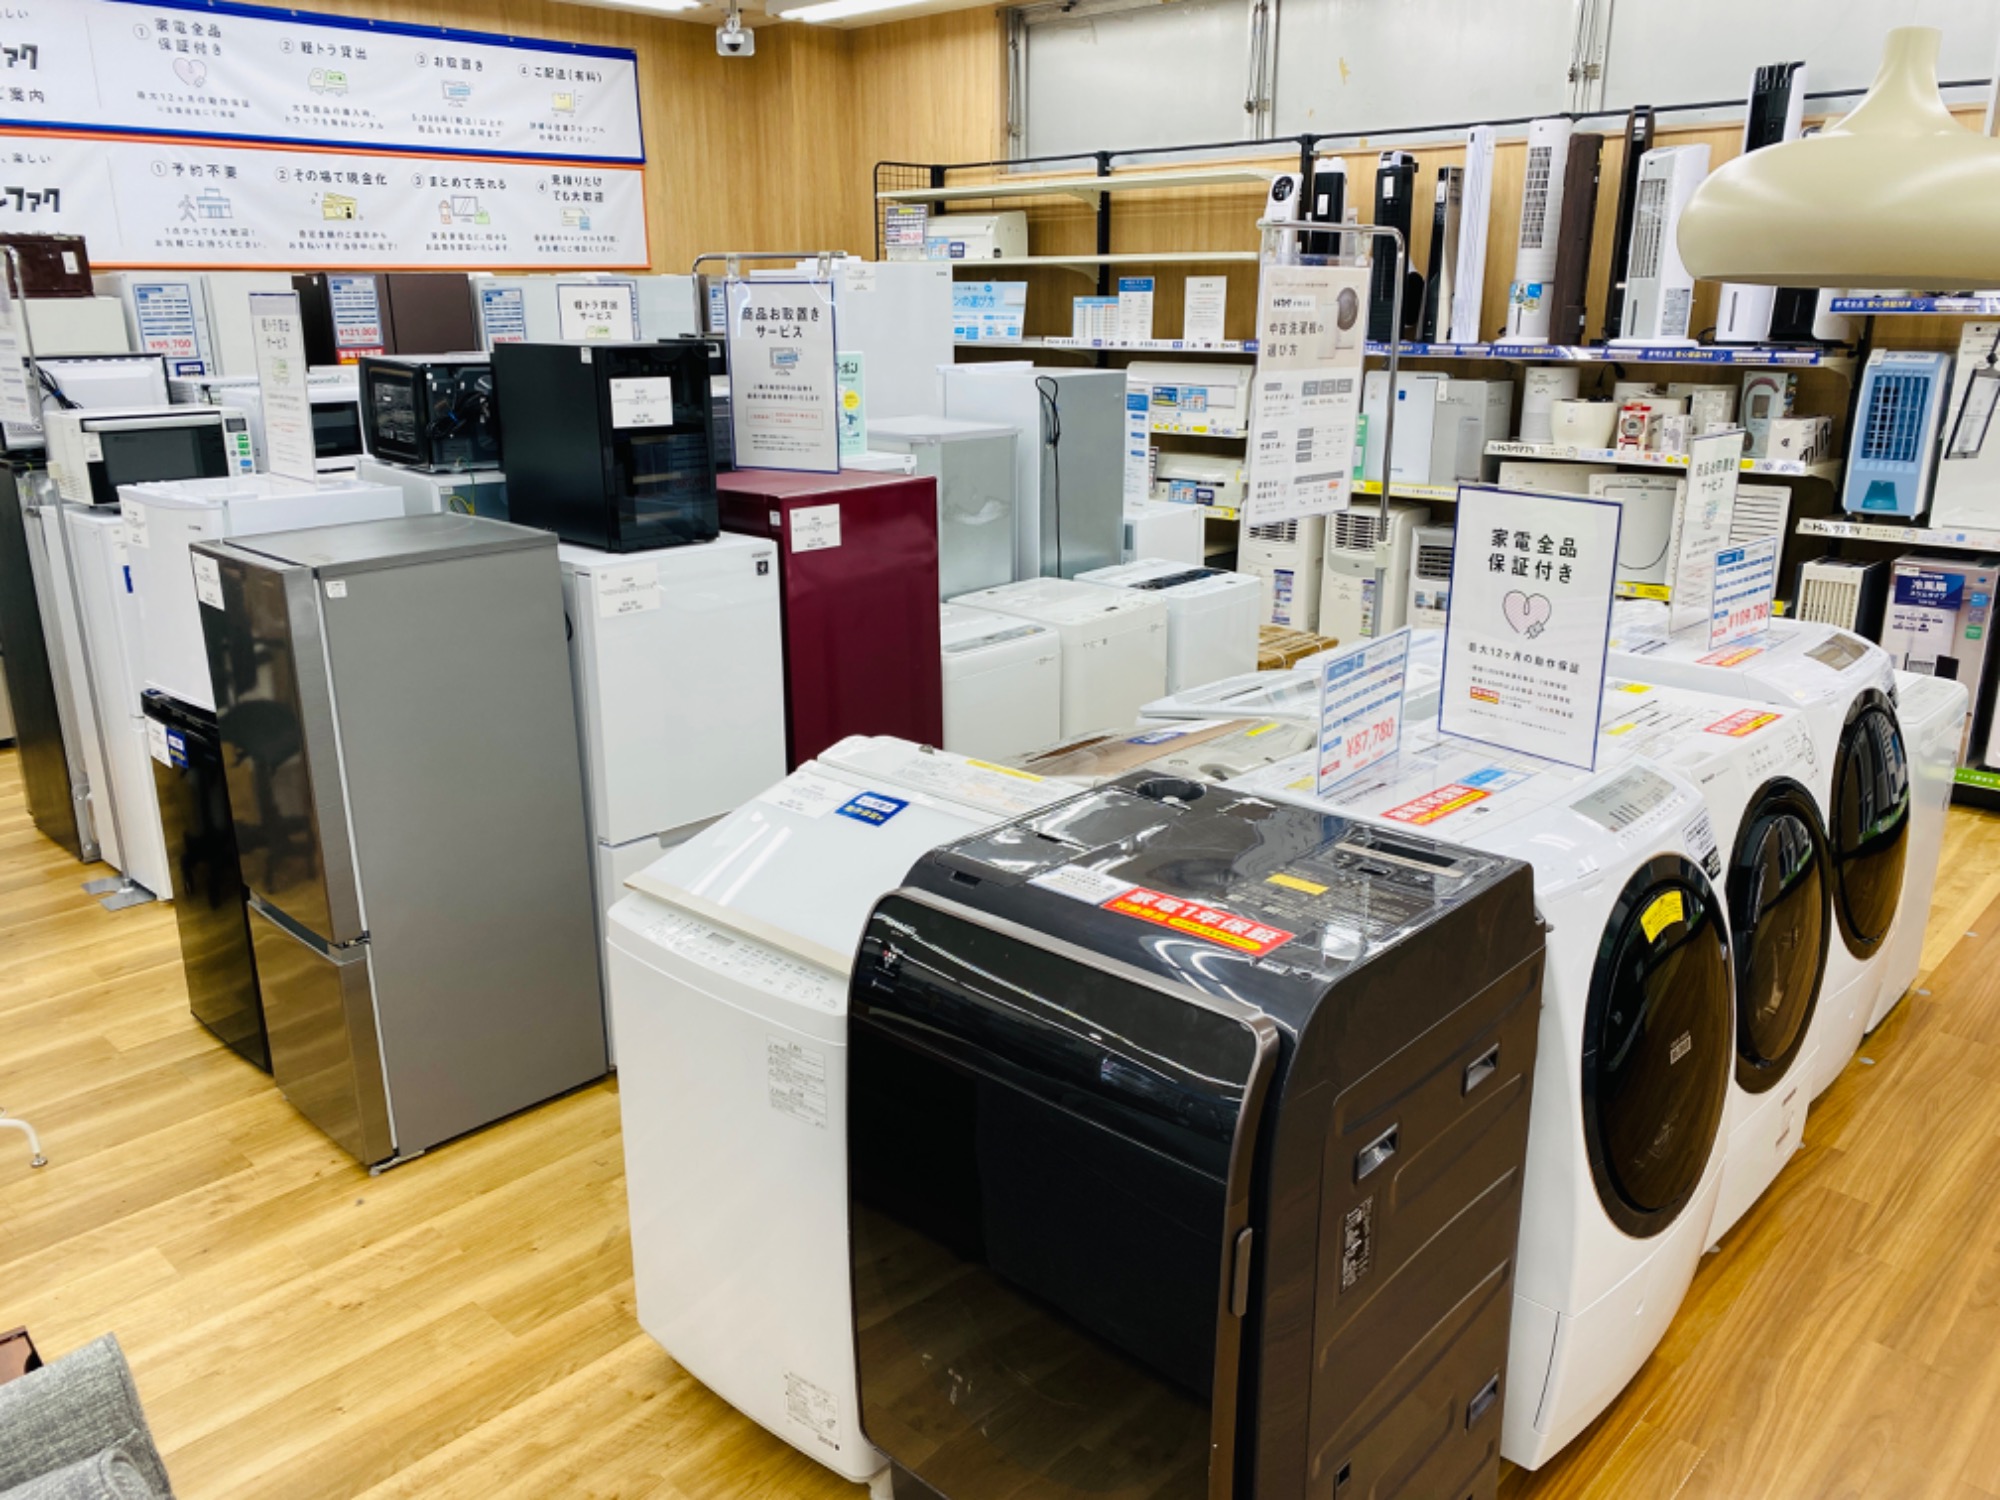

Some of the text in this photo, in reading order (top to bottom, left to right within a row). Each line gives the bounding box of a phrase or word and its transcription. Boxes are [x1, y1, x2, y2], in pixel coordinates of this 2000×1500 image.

[0, 8, 29, 19] しい
[155, 17, 222, 39] 家電全品
[158, 37, 222, 56] 保証付き
[300, 41, 368, 60] 軽トラ貸出
[0, 43, 39, 70] ァク
[433, 56, 484, 72] お取置き
[171, 162, 238, 179] 予約不要
[293, 170, 388, 187] その場で現金化
[429, 177, 506, 190] まとめて売れる
[551, 174, 602, 187] 見積りだけ
[573, 301, 618, 311] 軽トラ貸出
[741, 306, 821, 323] 商品お取置き
[580, 312, 613, 321] サービス
[755, 325, 804, 339] サービス
[1267, 343, 1298, 358] 選び方
[1491, 528, 1578, 559] 家電全品
[1487, 553, 1574, 584] 保証付き
[1468, 641, 1581, 675] 最大12ヶ月の動作保証
[1346, 716, 1395, 758] ¥87,780
[1126, 891, 1283, 944] 家電1年保証
